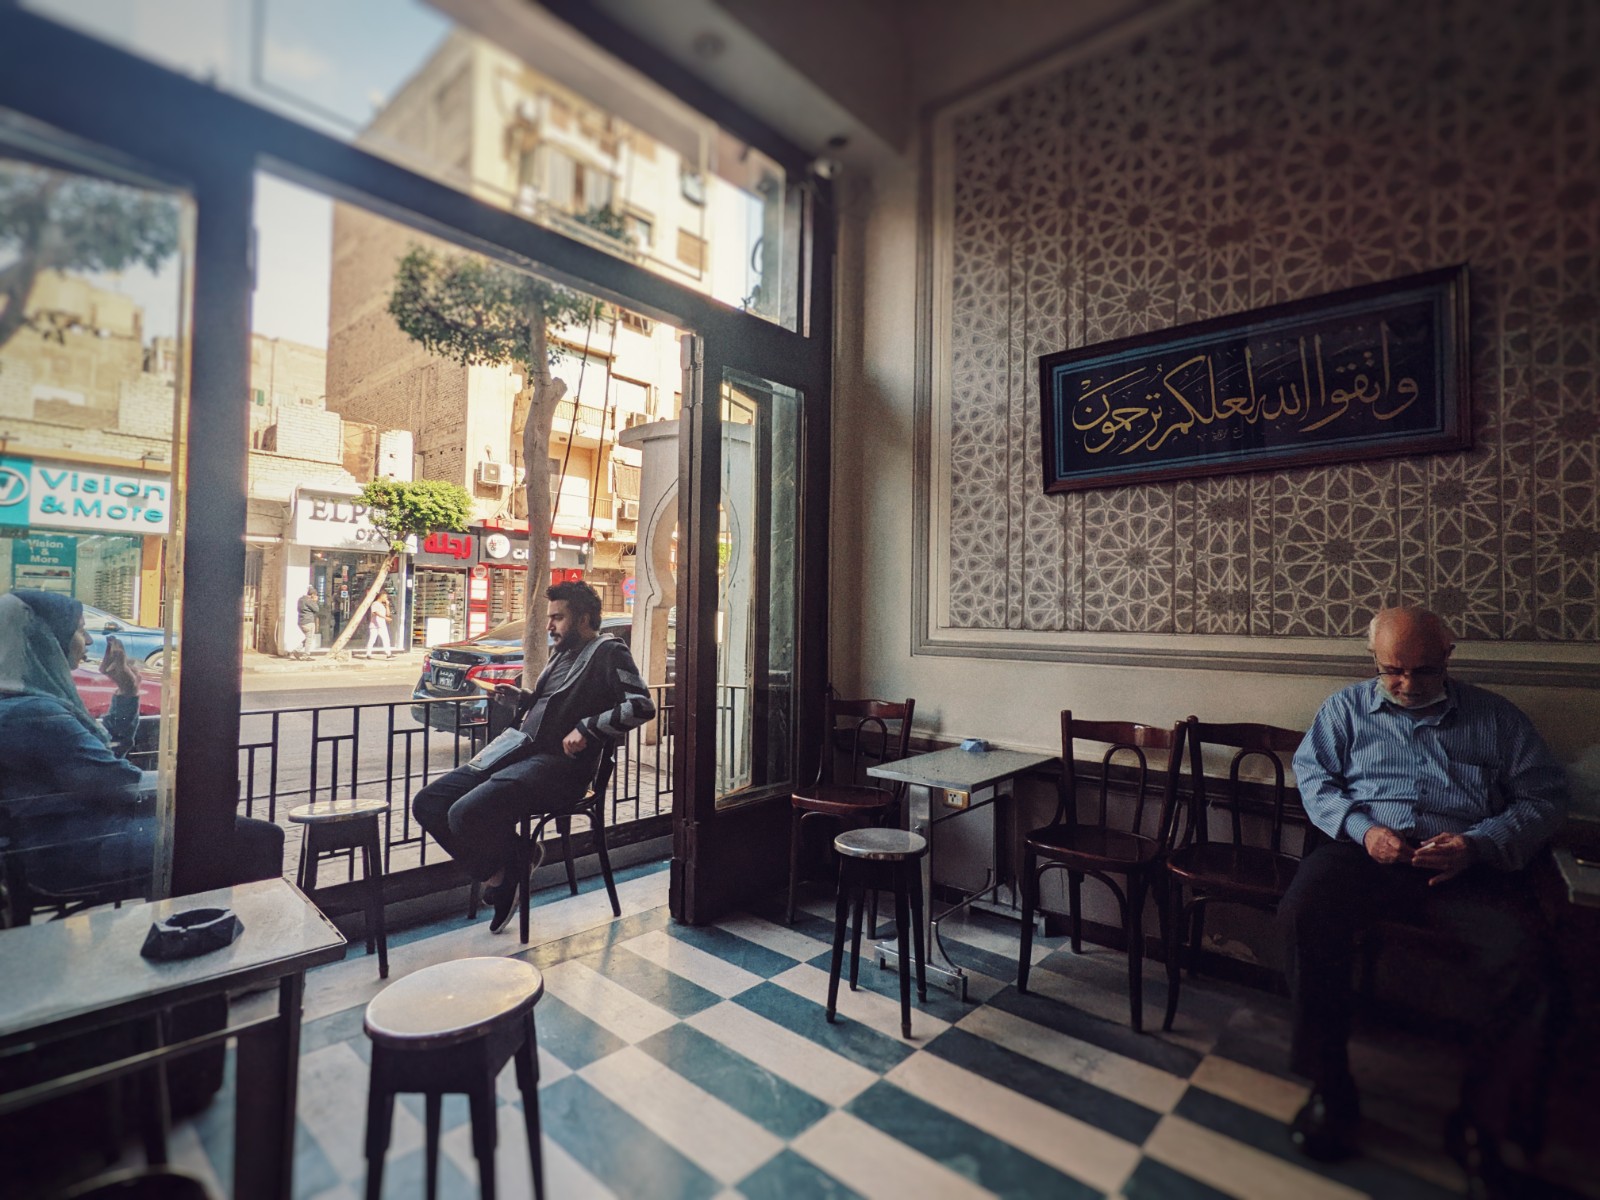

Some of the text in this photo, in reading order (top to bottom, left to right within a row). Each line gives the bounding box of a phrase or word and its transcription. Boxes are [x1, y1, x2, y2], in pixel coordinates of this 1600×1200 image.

[1245, 335, 1311, 424] الله
[1299, 320, 1419, 432] واتقوا
[39, 469, 165, 501] Vision
[28, 539, 64, 549] Vision
[30, 555, 59, 563] More
